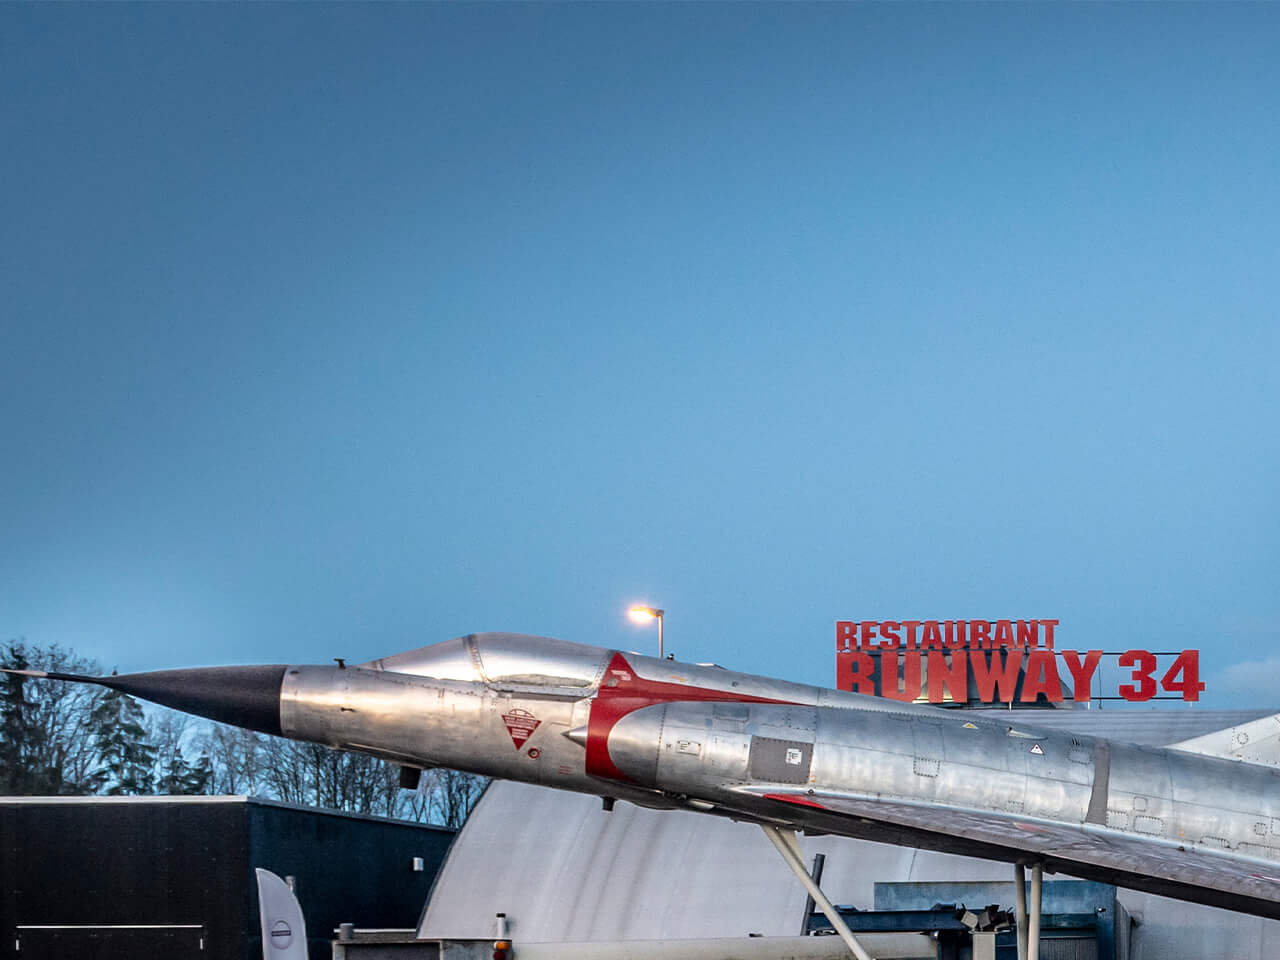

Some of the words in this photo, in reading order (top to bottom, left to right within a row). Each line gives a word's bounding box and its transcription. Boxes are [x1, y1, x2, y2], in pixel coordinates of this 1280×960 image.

[836, 619, 1059, 650] RESTAURANT
[836, 650, 1103, 703] RUNWAY
[1118, 649, 1205, 702] 34
